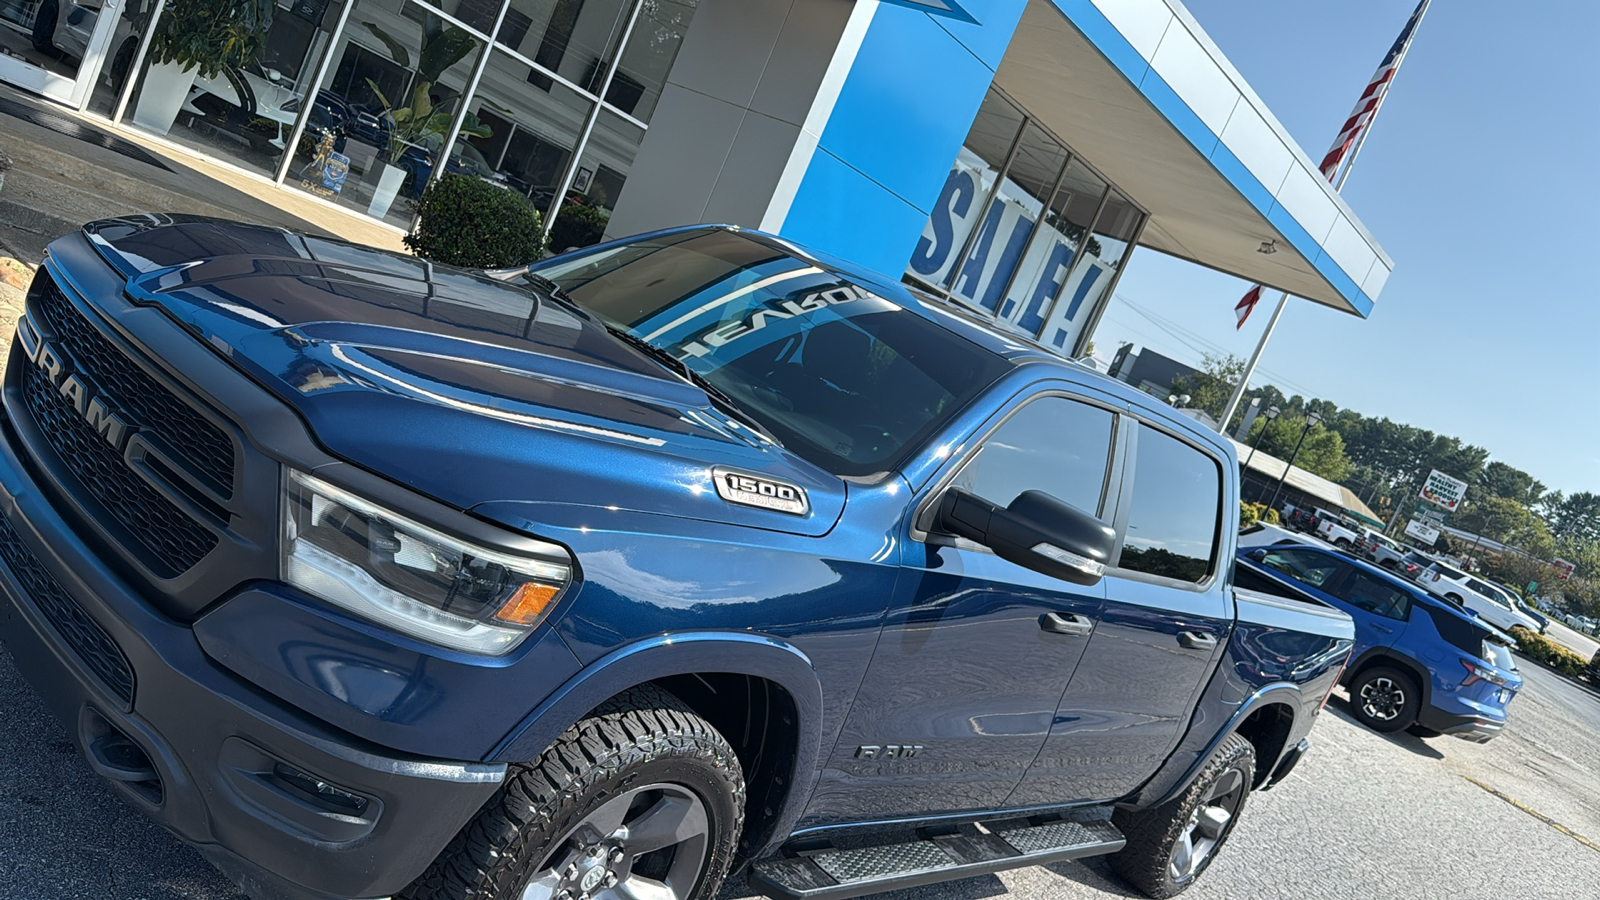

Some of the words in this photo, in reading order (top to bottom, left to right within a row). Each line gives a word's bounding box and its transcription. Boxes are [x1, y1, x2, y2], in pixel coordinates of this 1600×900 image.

[910, 169, 1105, 350] SALE!
[37, 341, 127, 449] RAM
[727, 475, 795, 500] 1500
[1429, 475, 1457, 491] HEALTHY
[1429, 481, 1459, 497] HARVEST
[854, 744, 924, 760] RAM
